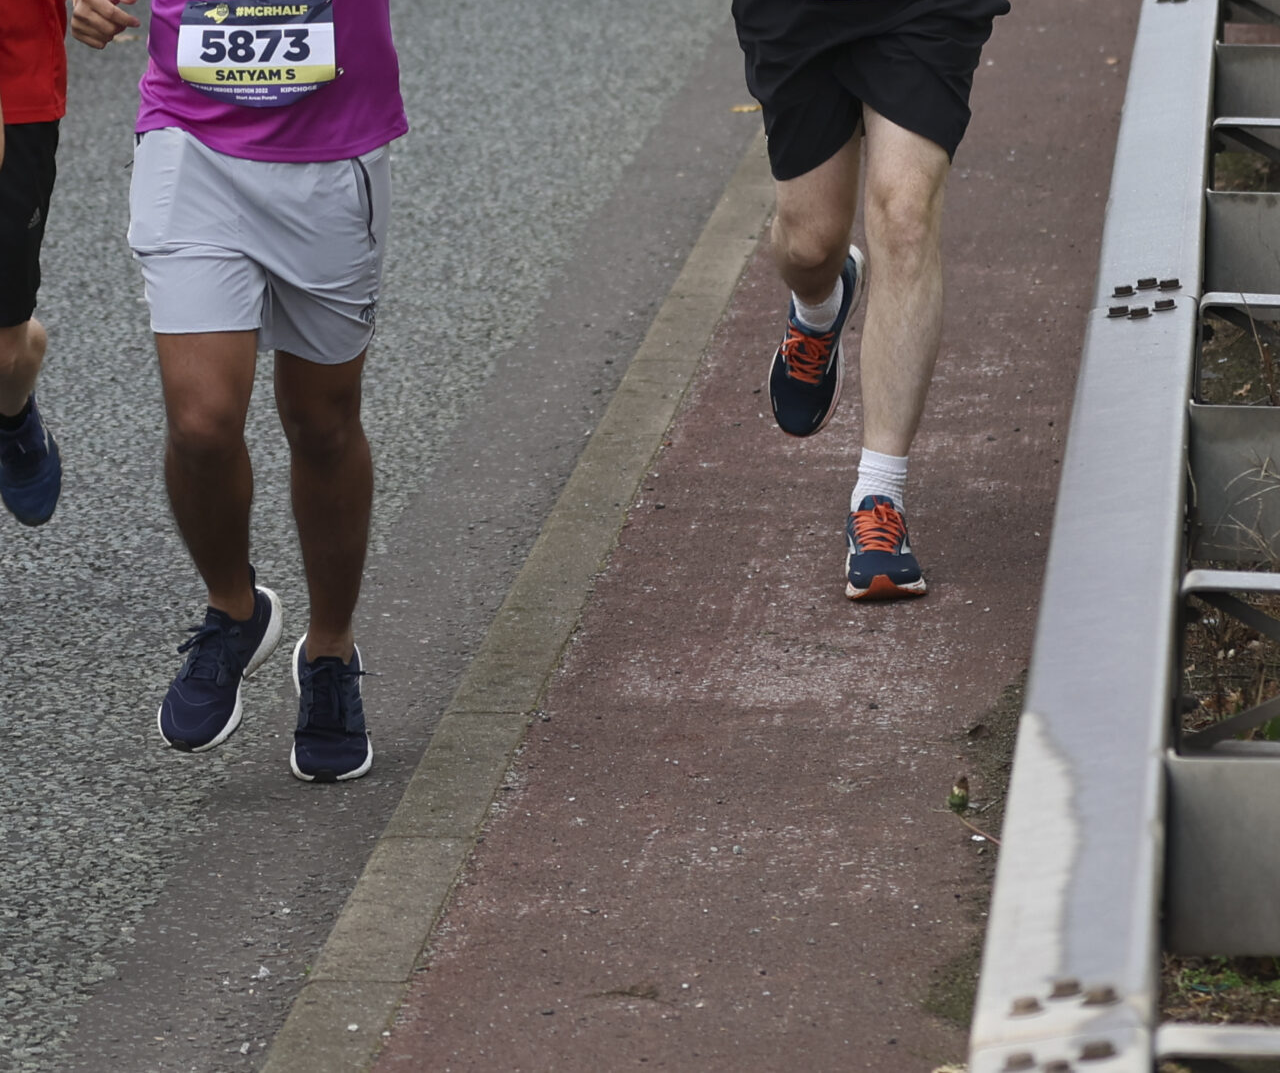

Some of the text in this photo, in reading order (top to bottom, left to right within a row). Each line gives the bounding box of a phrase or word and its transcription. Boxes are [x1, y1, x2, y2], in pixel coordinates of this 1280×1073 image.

[236, 5, 308, 17] #MCRHALF
[200, 29, 310, 64] 5873
[215, 68, 296, 82] SATYAM S
[280, 84, 318, 94] KIPCHOGE
